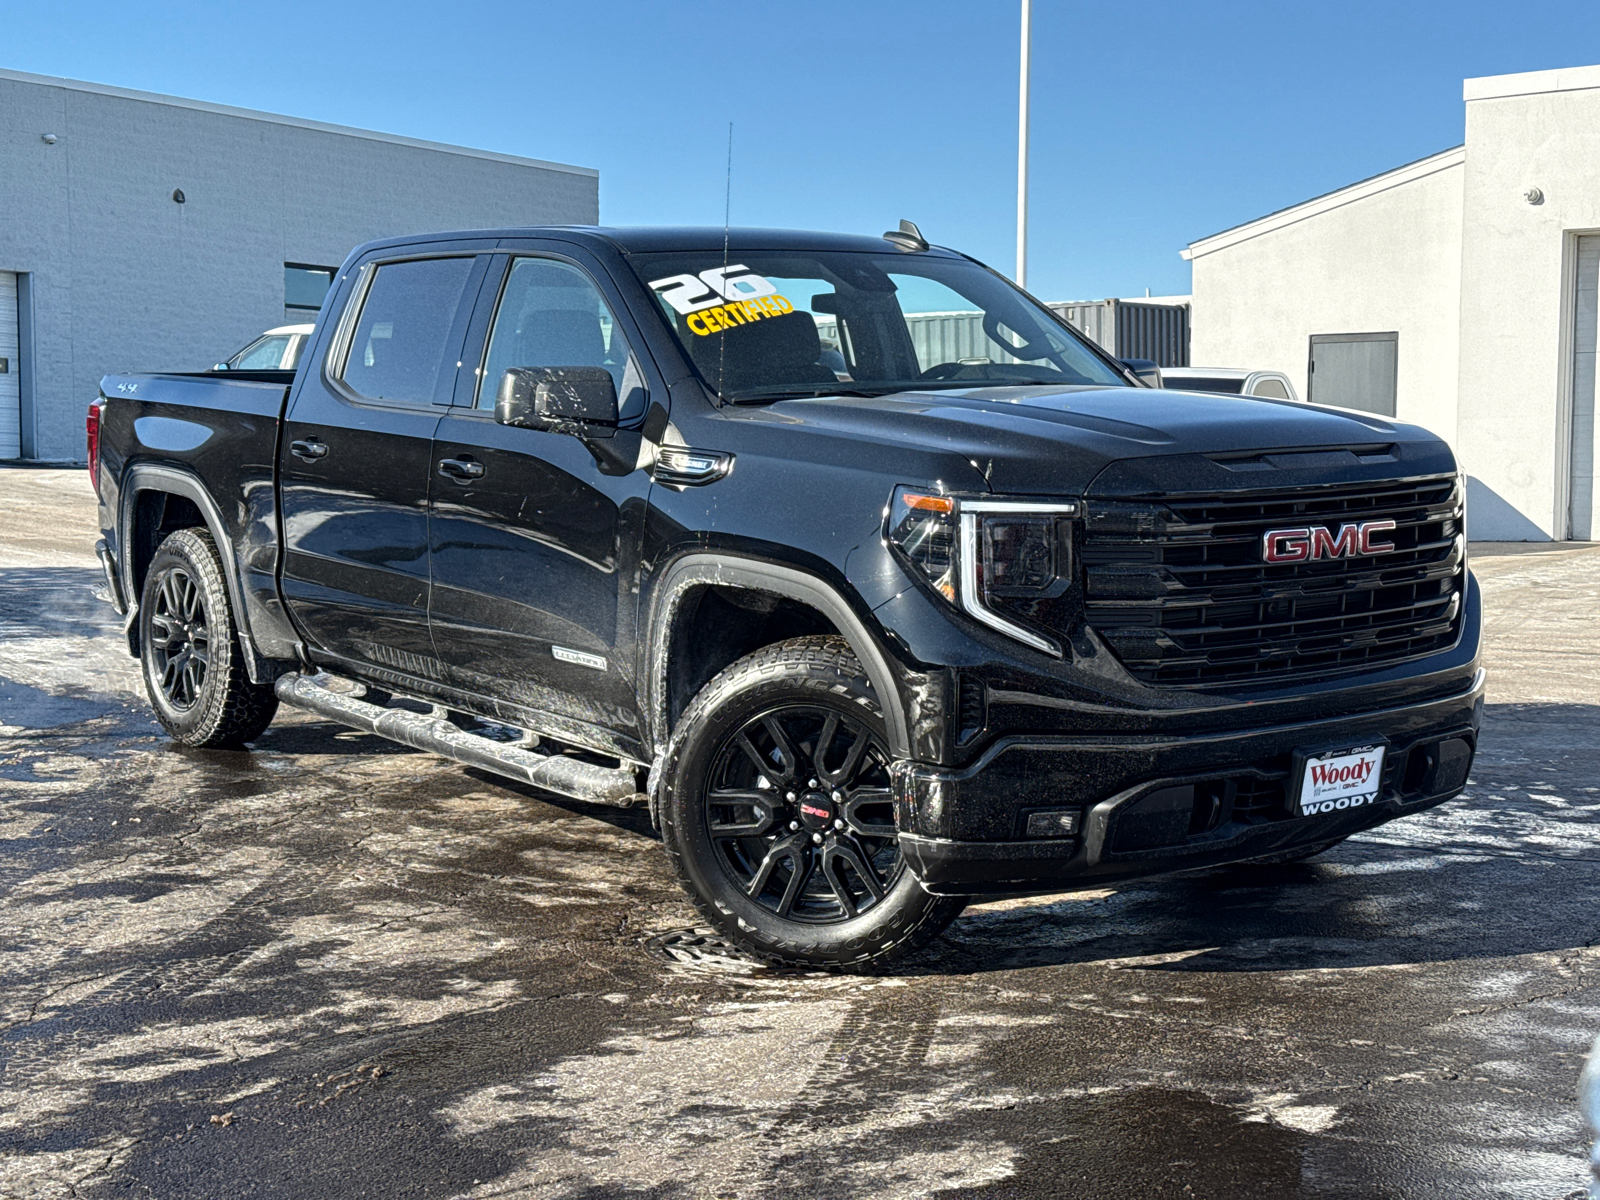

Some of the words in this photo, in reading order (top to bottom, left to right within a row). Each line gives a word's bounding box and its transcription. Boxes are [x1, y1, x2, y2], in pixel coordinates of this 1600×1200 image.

[647, 263, 777, 315] 26
[686, 294, 794, 336] CERTIFIED
[1263, 520, 1396, 563] GMC
[1310, 757, 1377, 788] Woody
[1342, 781, 1359, 790] GMC
[1302, 792, 1379, 816] WOODY
